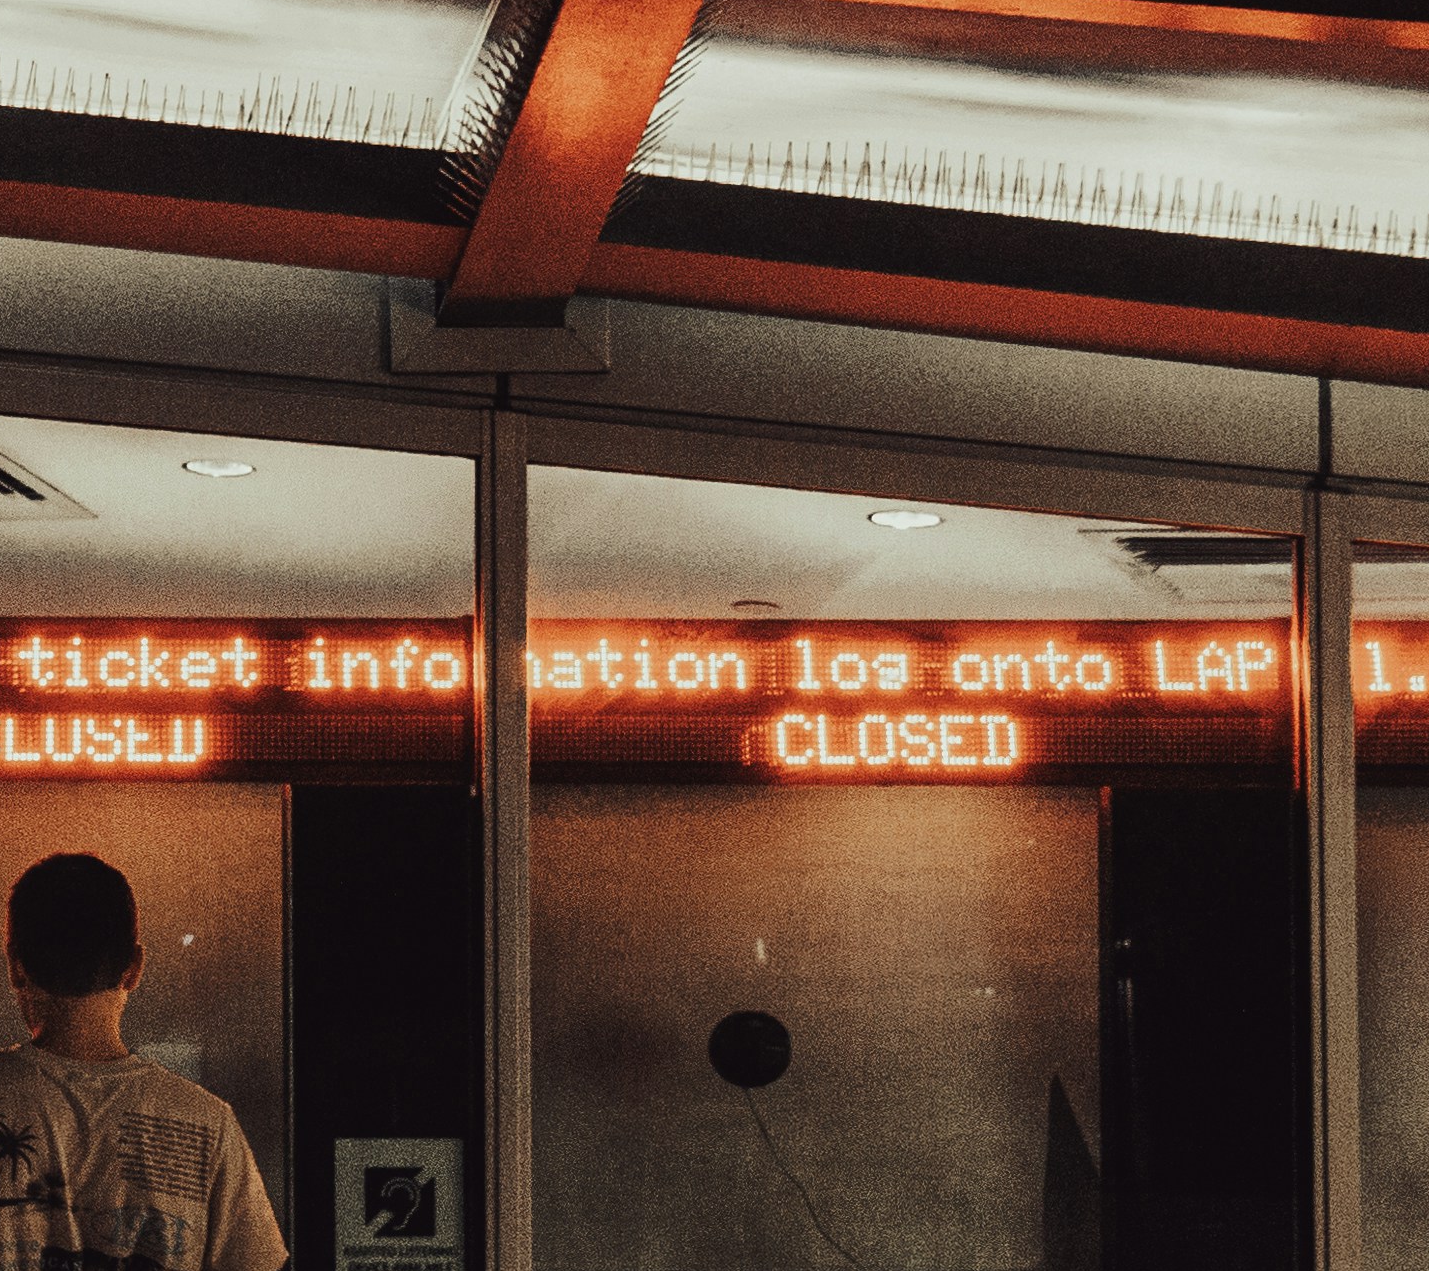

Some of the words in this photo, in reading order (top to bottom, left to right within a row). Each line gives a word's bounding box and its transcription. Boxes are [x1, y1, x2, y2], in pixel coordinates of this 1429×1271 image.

[17, 637, 259, 688] ticket
[951, 640, 1113, 691] onto
[775, 714, 1018, 766] CLOSED
